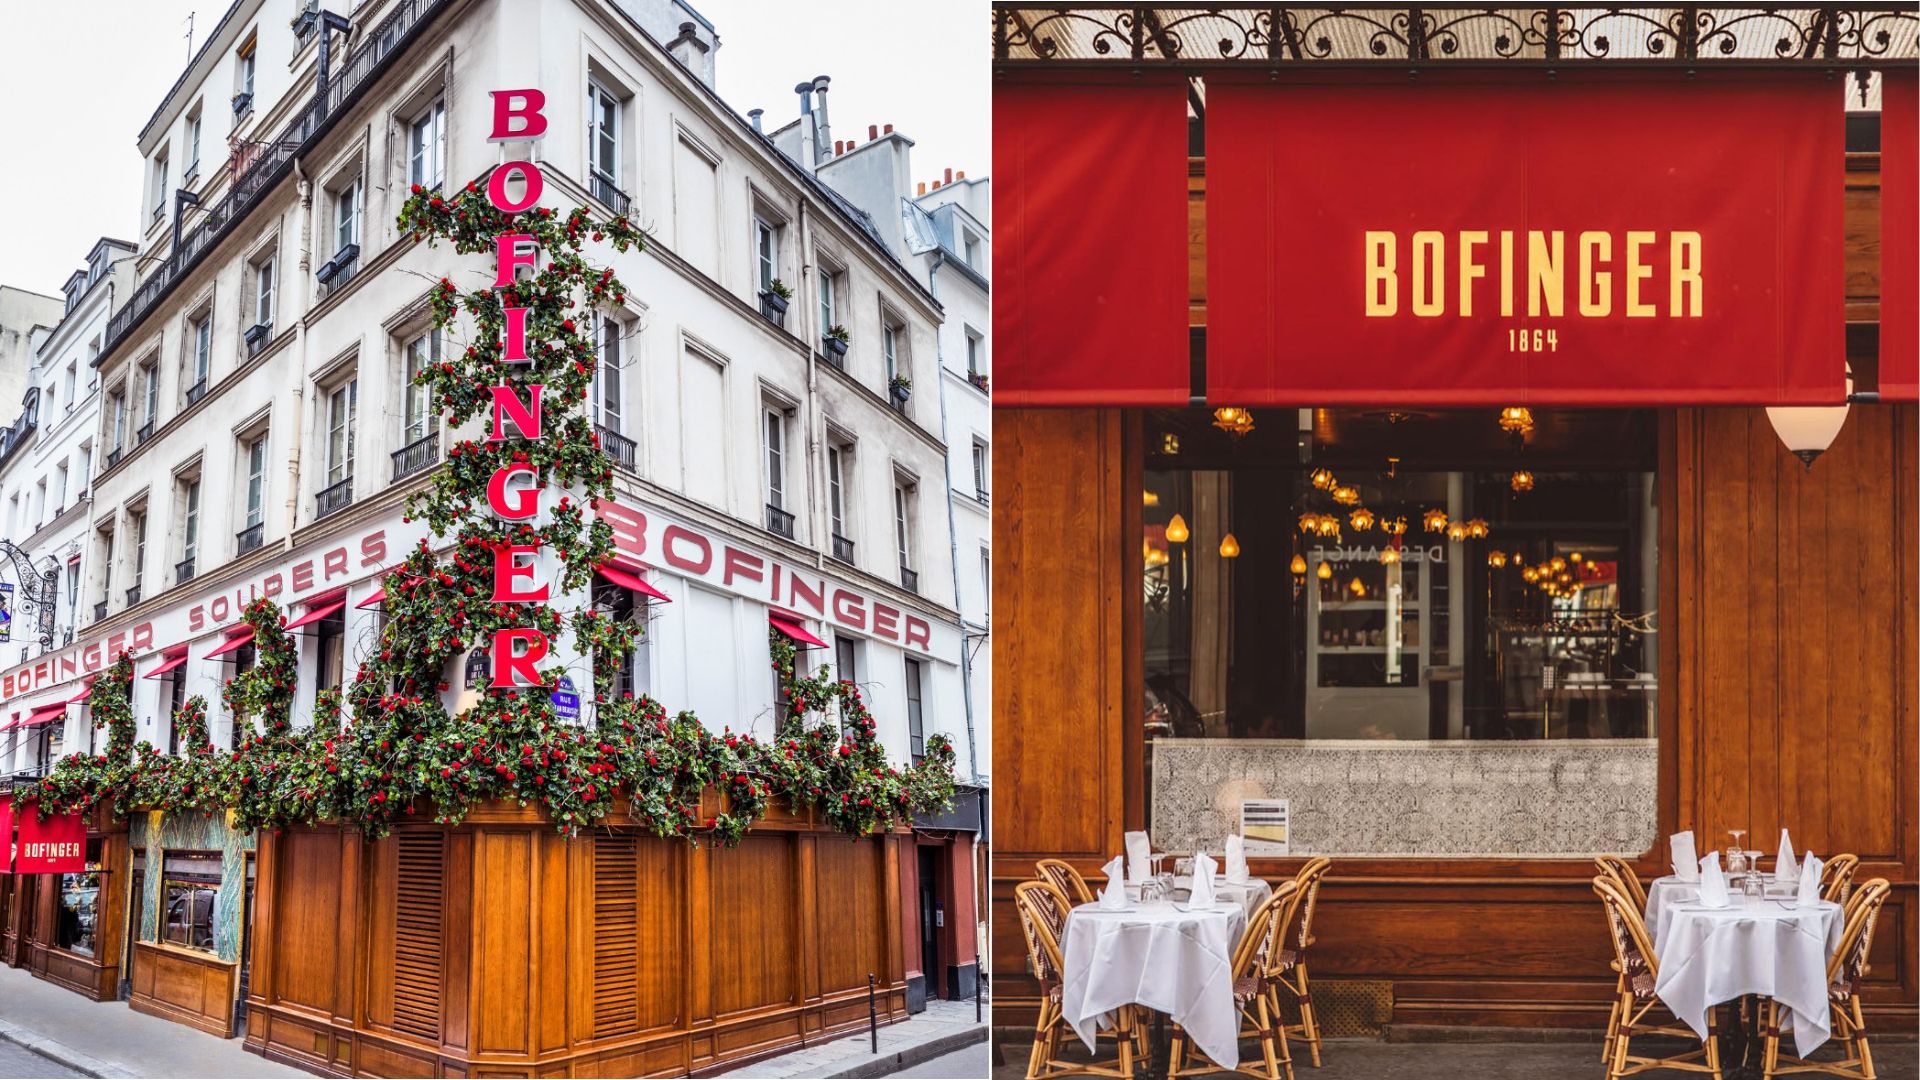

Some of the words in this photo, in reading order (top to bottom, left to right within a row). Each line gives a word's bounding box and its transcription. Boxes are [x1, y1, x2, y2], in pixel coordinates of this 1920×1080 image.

[1365, 230, 1703, 317] BOFINGER
[487, 88, 550, 688] BOFINGER
[1509, 329, 1558, 352] 1864
[3, 621, 154, 699] BOFINGER
[189, 529, 387, 633] SOUPERS
[597, 496, 931, 651] BOFINGER
[24, 842, 80, 858] BOFINGER
